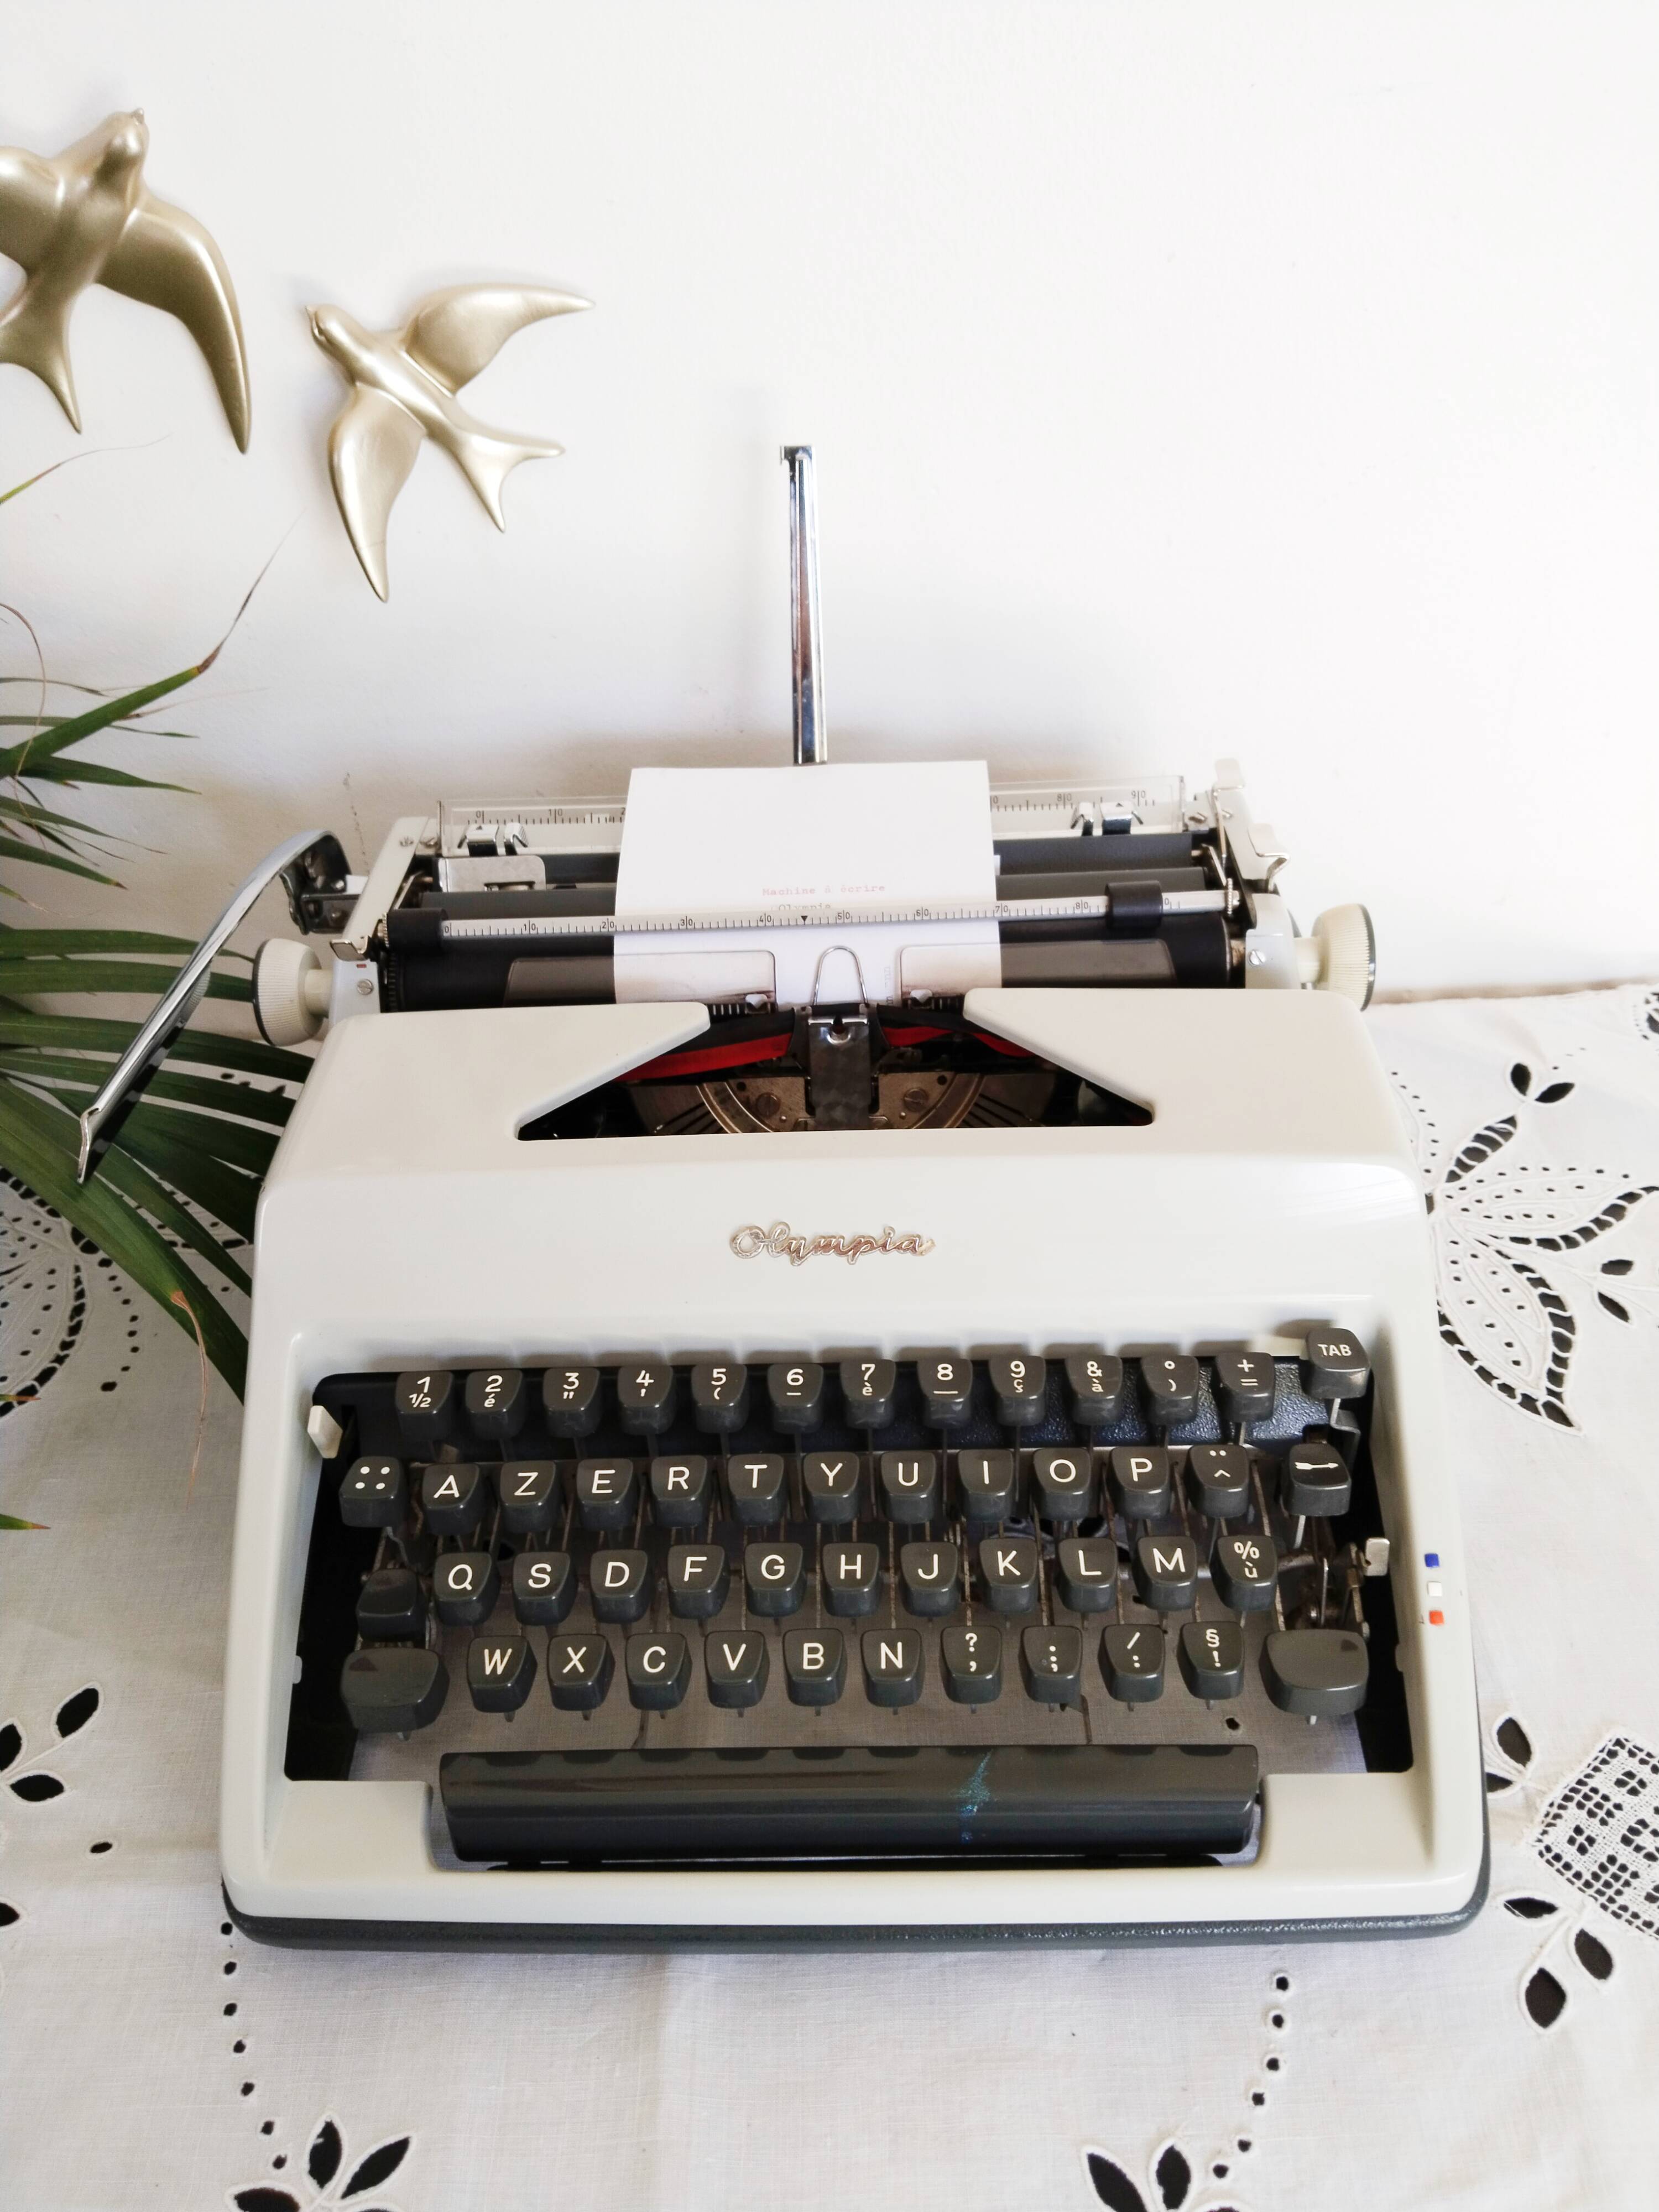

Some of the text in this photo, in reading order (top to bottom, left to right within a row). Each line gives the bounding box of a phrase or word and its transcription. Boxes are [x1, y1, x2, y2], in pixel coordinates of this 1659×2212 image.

[1057, 792, 1072, 802] 80
[1131, 790, 1146, 799] 90
[761, 886, 816, 896] Machine
[524, 922, 536, 932] 10
[602, 921, 615, 930] 20
[680, 918, 693, 927] 30
[759, 914, 772, 924] 40
[837, 911, 851, 920] 50
[995, 905, 1009, 914] 70
[1076, 901, 1089, 911] 80
[729, 1220, 937, 1267] Olympia
[1317, 1344, 1352, 1357] TAB
[711, 1368, 726, 1385] 5
[786, 1368, 804, 1386] 6
[862, 1364, 875, 1381] 7
[937, 1363, 953, 1381] 8
[1010, 1360, 1025, 1378] 9
[1087, 1361, 1103, 1377] &
[1237, 1359, 1254, 1372] +
[416, 1376, 431, 1394] 1
[485, 1375, 503, 1392] 2
[563, 1373, 579, 1390] 3
[636, 1370, 654, 1386] 4
[862, 1383, 873, 1396] è
[1014, 1379, 1024, 1393] ç
[1091, 1379, 1104, 1392] à
[1168, 1379, 1177, 1392] )
[484, 1394, 495, 1408] é
[667, 1467, 690, 1490] R
[744, 1464, 768, 1488] T
[821, 1463, 843, 1486] Y
[898, 1462, 919, 1486] U
[983, 1460, 989, 1484] I
[1049, 1459, 1076, 1483] O
[1130, 1458, 1152, 1481] P
[434, 1475, 460, 1498] A
[514, 1472, 539, 1496] Z
[592, 1469, 615, 1494] E
[1152, 1547, 1186, 1573] M
[1234, 1541, 1260, 1559] %
[684, 1556, 707, 1582] F
[761, 1554, 785, 1580] G
[840, 1554, 862, 1579] H
[917, 1554, 938, 1579] J
[997, 1550, 1021, 1576] K
[1078, 1550, 1102, 1575] L
[1244, 1561, 1258, 1578] ù
[448, 1564, 472, 1590] Q
[528, 1563, 551, 1588] S
[604, 1562, 629, 1587] D
[965, 1632, 977, 1652] ?
[1127, 1632, 1140, 1649] /
[1206, 1629, 1220, 1647] §
[483, 1648, 512, 1675] W
[562, 1646, 587, 1673] X
[643, 1646, 666, 1673] C
[723, 1644, 747, 1671] V
[803, 1642, 824, 1670] B
[880, 1641, 902, 1670] N
[1212, 1651, 1221, 1667] !
